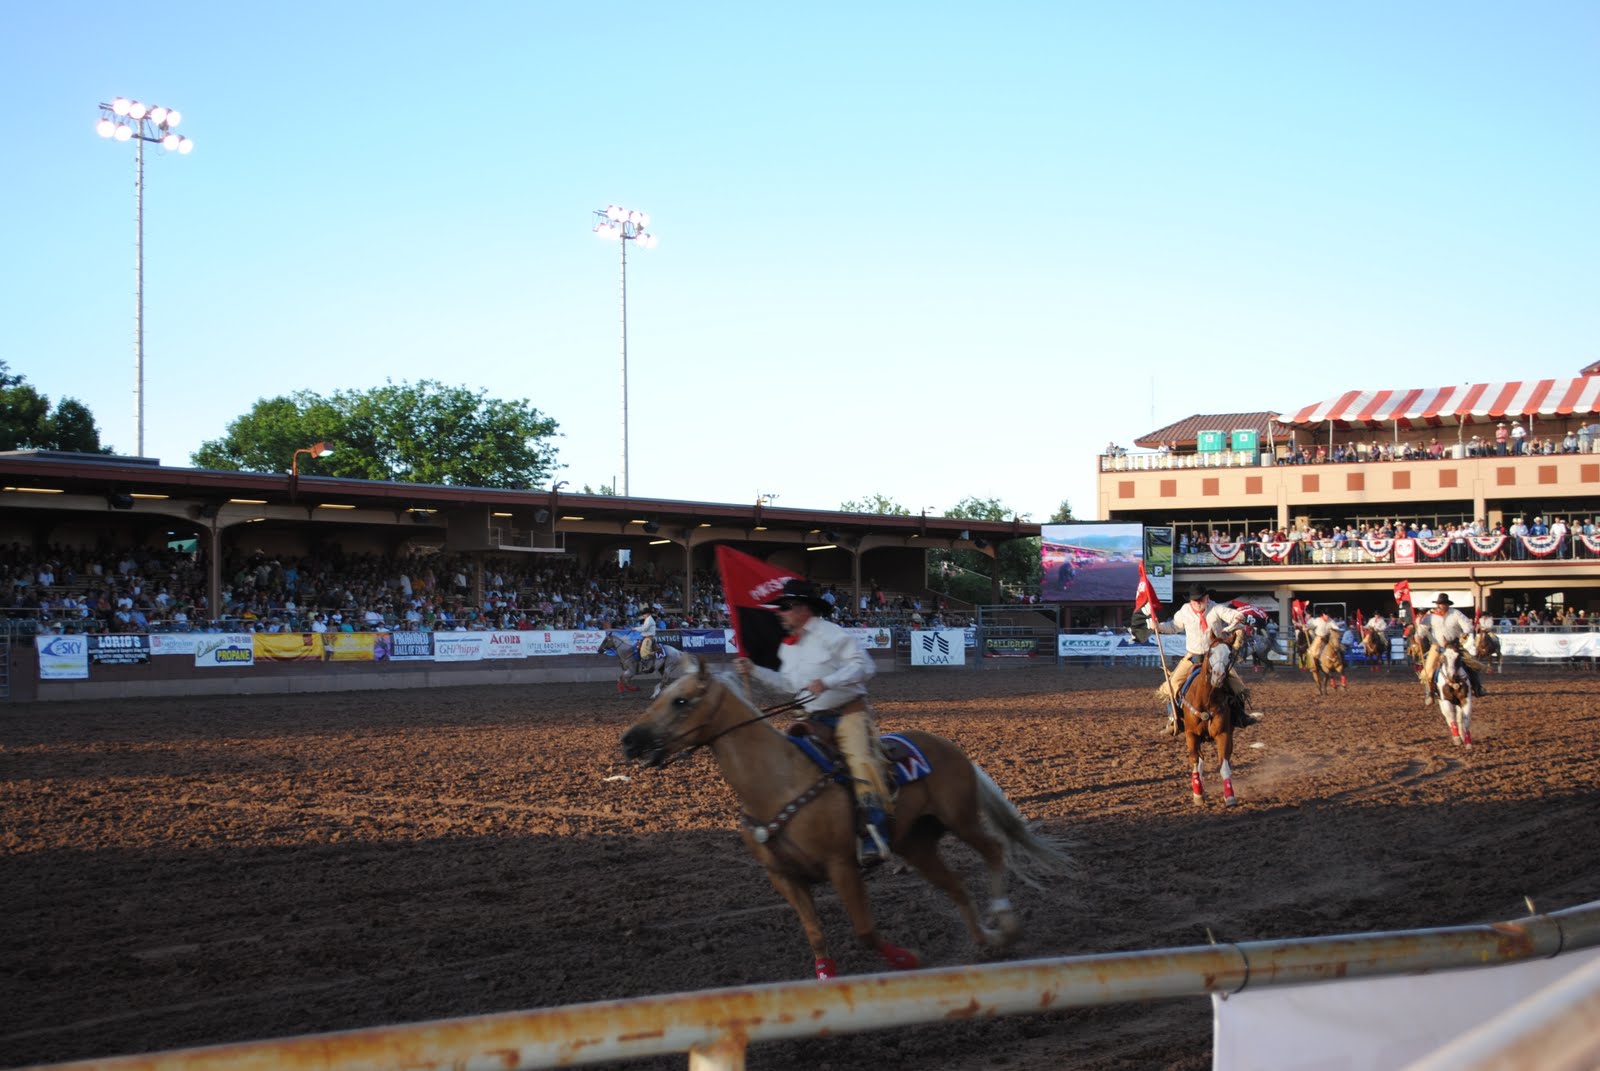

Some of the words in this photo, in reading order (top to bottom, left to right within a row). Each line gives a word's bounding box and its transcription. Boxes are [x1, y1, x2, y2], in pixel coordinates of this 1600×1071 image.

[98, 636, 141, 648] LORIG'S
[1065, 639, 1108, 648] LAMAR
[62, 642, 82, 655] SKY
[394, 645, 408, 656] HALL
[217, 650, 251, 661] PROPANE
[922, 655, 949, 665] USAA
